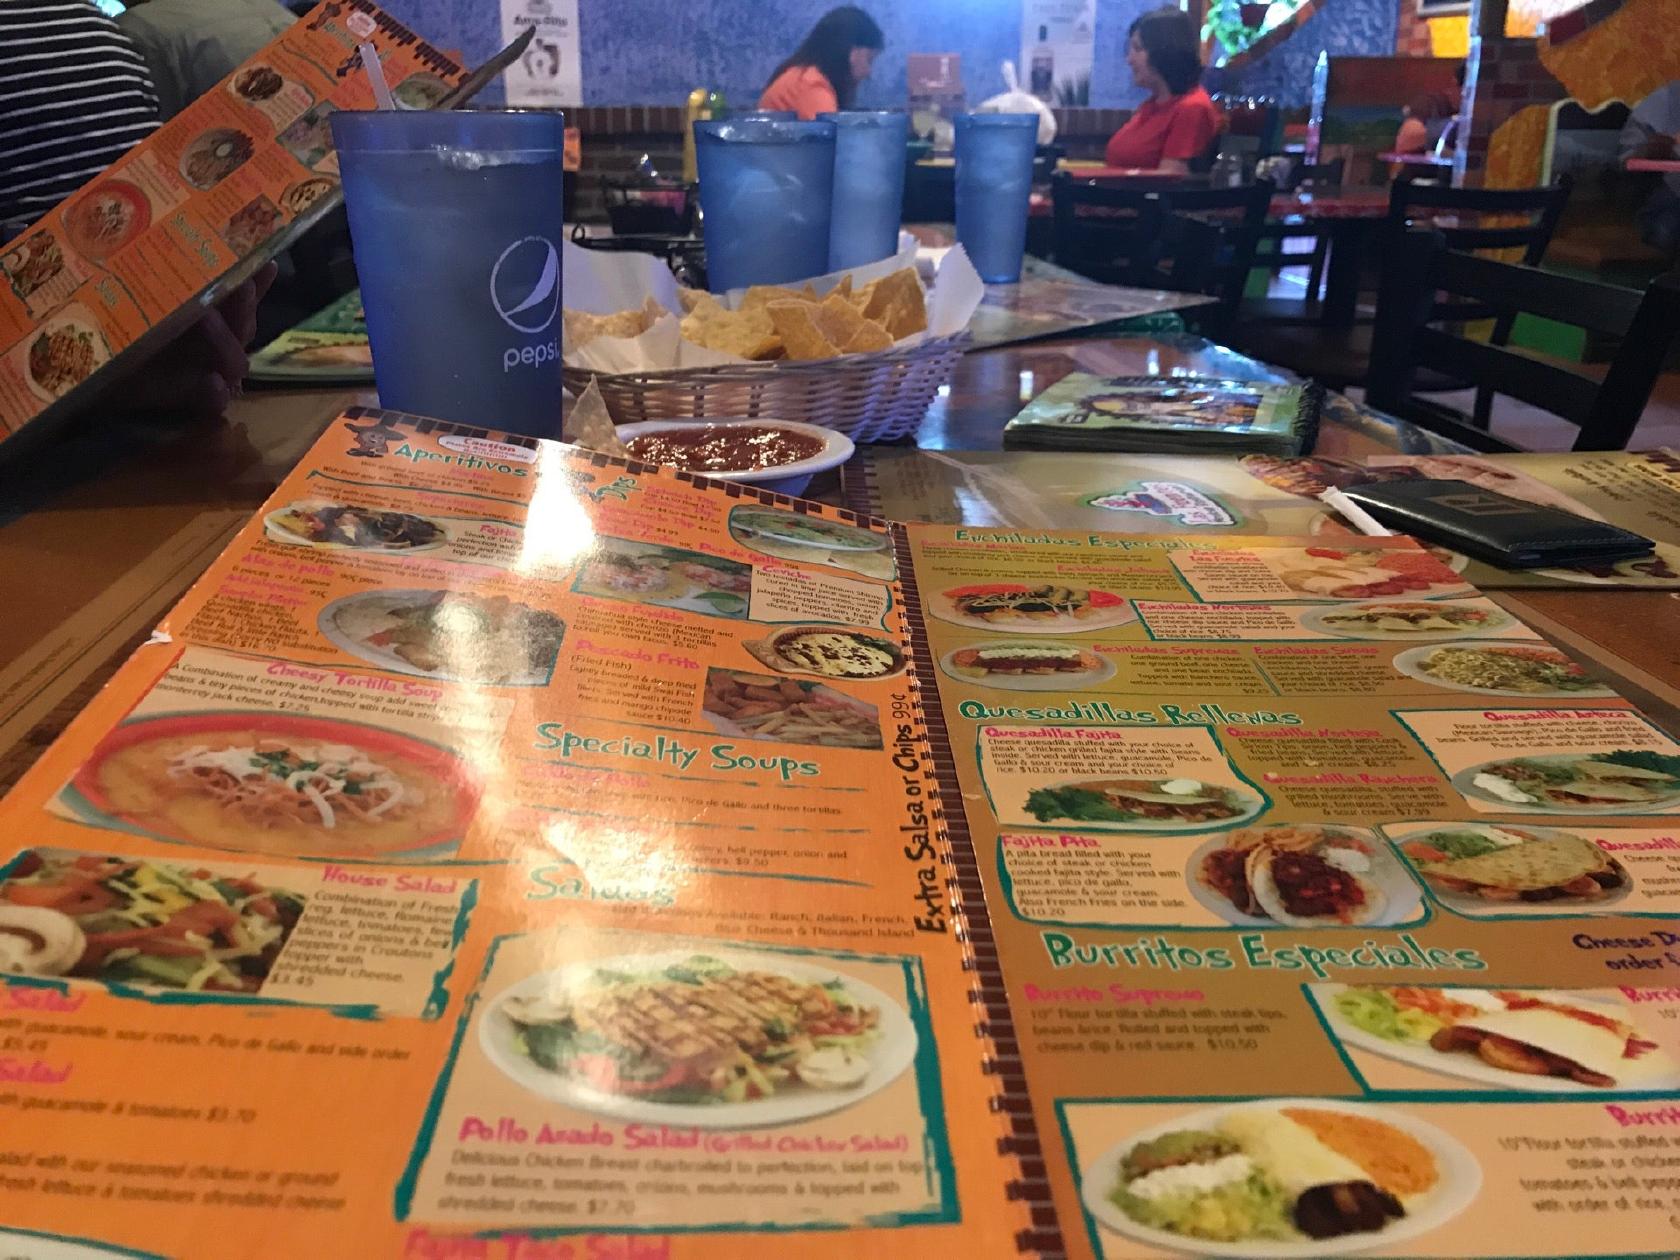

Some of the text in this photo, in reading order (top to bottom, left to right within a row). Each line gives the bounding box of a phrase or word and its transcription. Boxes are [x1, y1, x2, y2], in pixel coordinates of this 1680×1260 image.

[504, 337, 558, 372] pepsi
[393, 443, 528, 477] Aperitivos
[576, 639, 700, 670] Pescado Frito
[267, 662, 443, 702] Cheesy Tortilla Soup
[958, 699, 1304, 727] Quesadillas Rellenas
[1483, 711, 1570, 722] Quesadilla
[892, 724, 924, 773] Chips
[984, 726, 1122, 741] Quesadilla Fajita
[532, 722, 821, 781] Specialty Soups
[902, 775, 922, 797] or
[900, 800, 936, 861] Salsa
[1001, 835, 1101, 849] Fajita Pita
[1595, 837, 1680, 851] Quesadill
[322, 865, 458, 894] House Salad
[913, 865, 947, 934] Extra
[1040, 931, 1489, 979] Burritos Especiales
[1573, 933, 1655, 950] Cheese
[1605, 954, 1664, 970] order
[459, 1117, 528, 1144] Pollo
[623, 1123, 699, 1151] Salad
